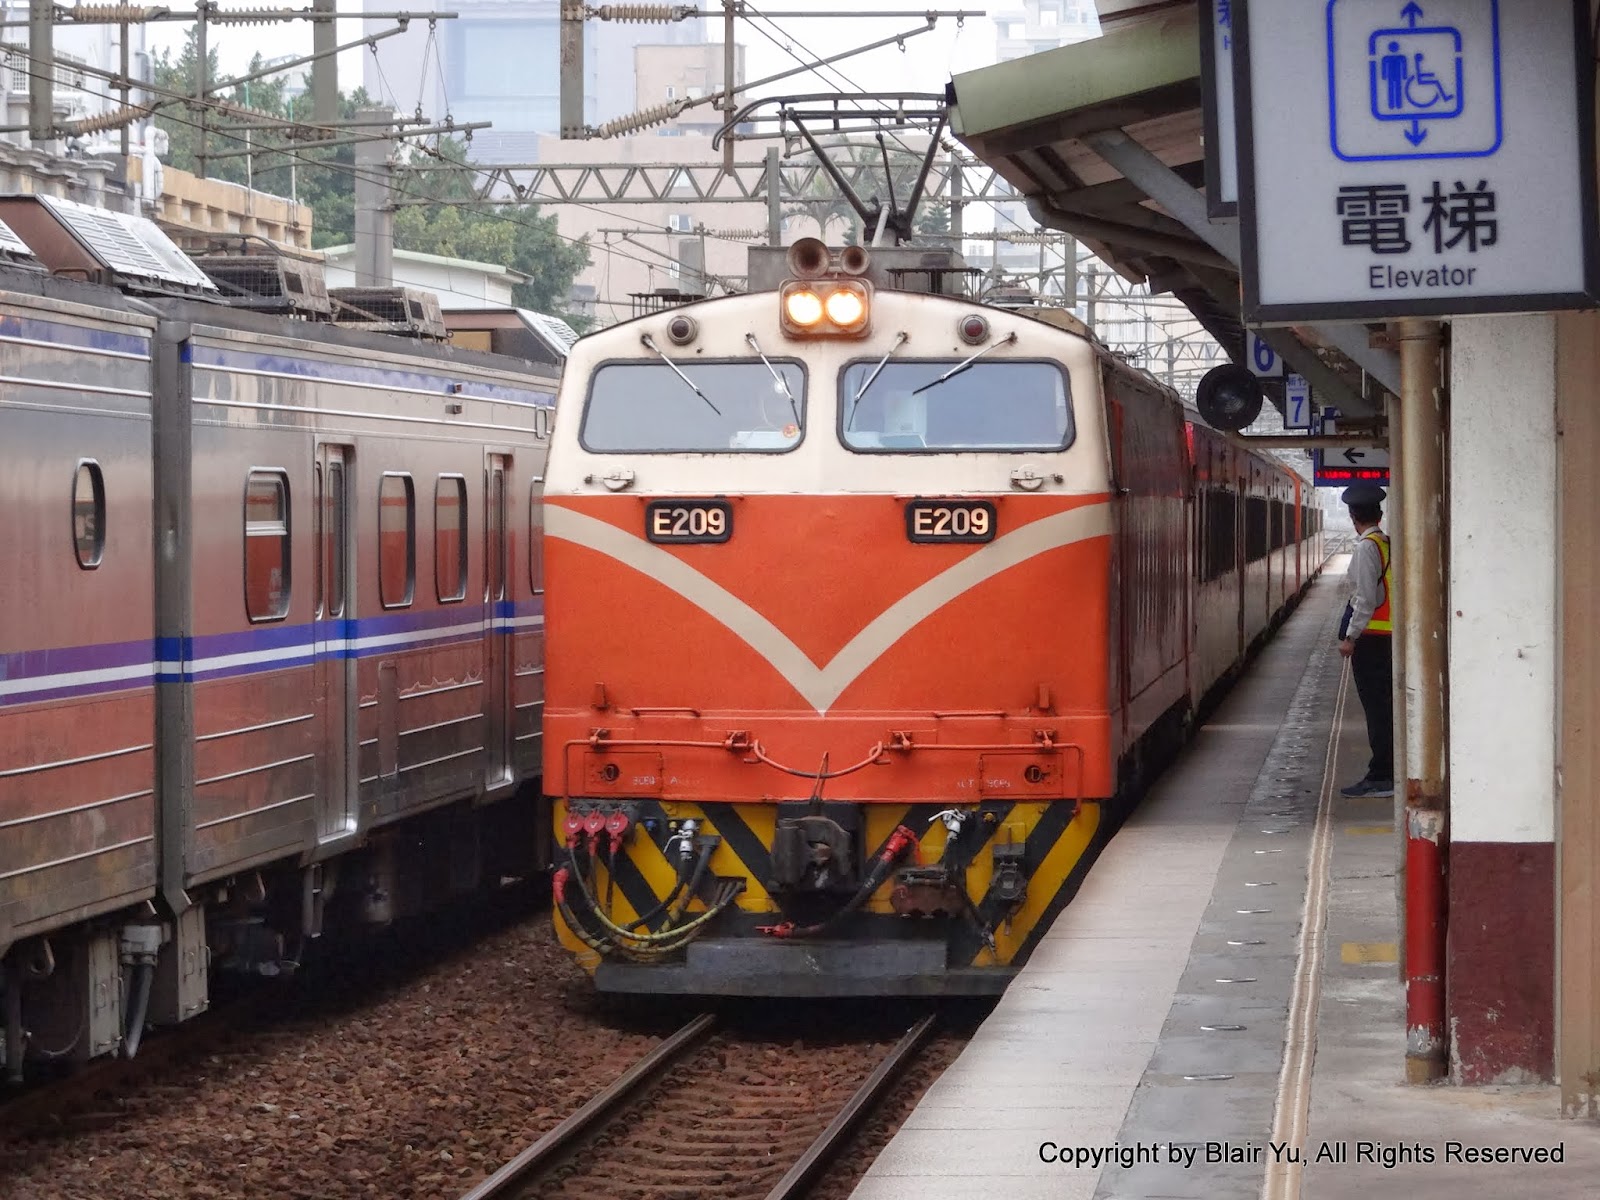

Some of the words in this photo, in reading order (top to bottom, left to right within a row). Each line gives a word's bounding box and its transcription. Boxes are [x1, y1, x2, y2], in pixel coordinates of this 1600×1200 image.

[1336, 179, 1499, 255] 電梯
[1369, 264, 1477, 290] Elevator
[1253, 334, 1275, 372] 6
[1291, 396, 1304, 423] 7
[653, 507, 726, 536] E209
[914, 507, 990, 536] E209
